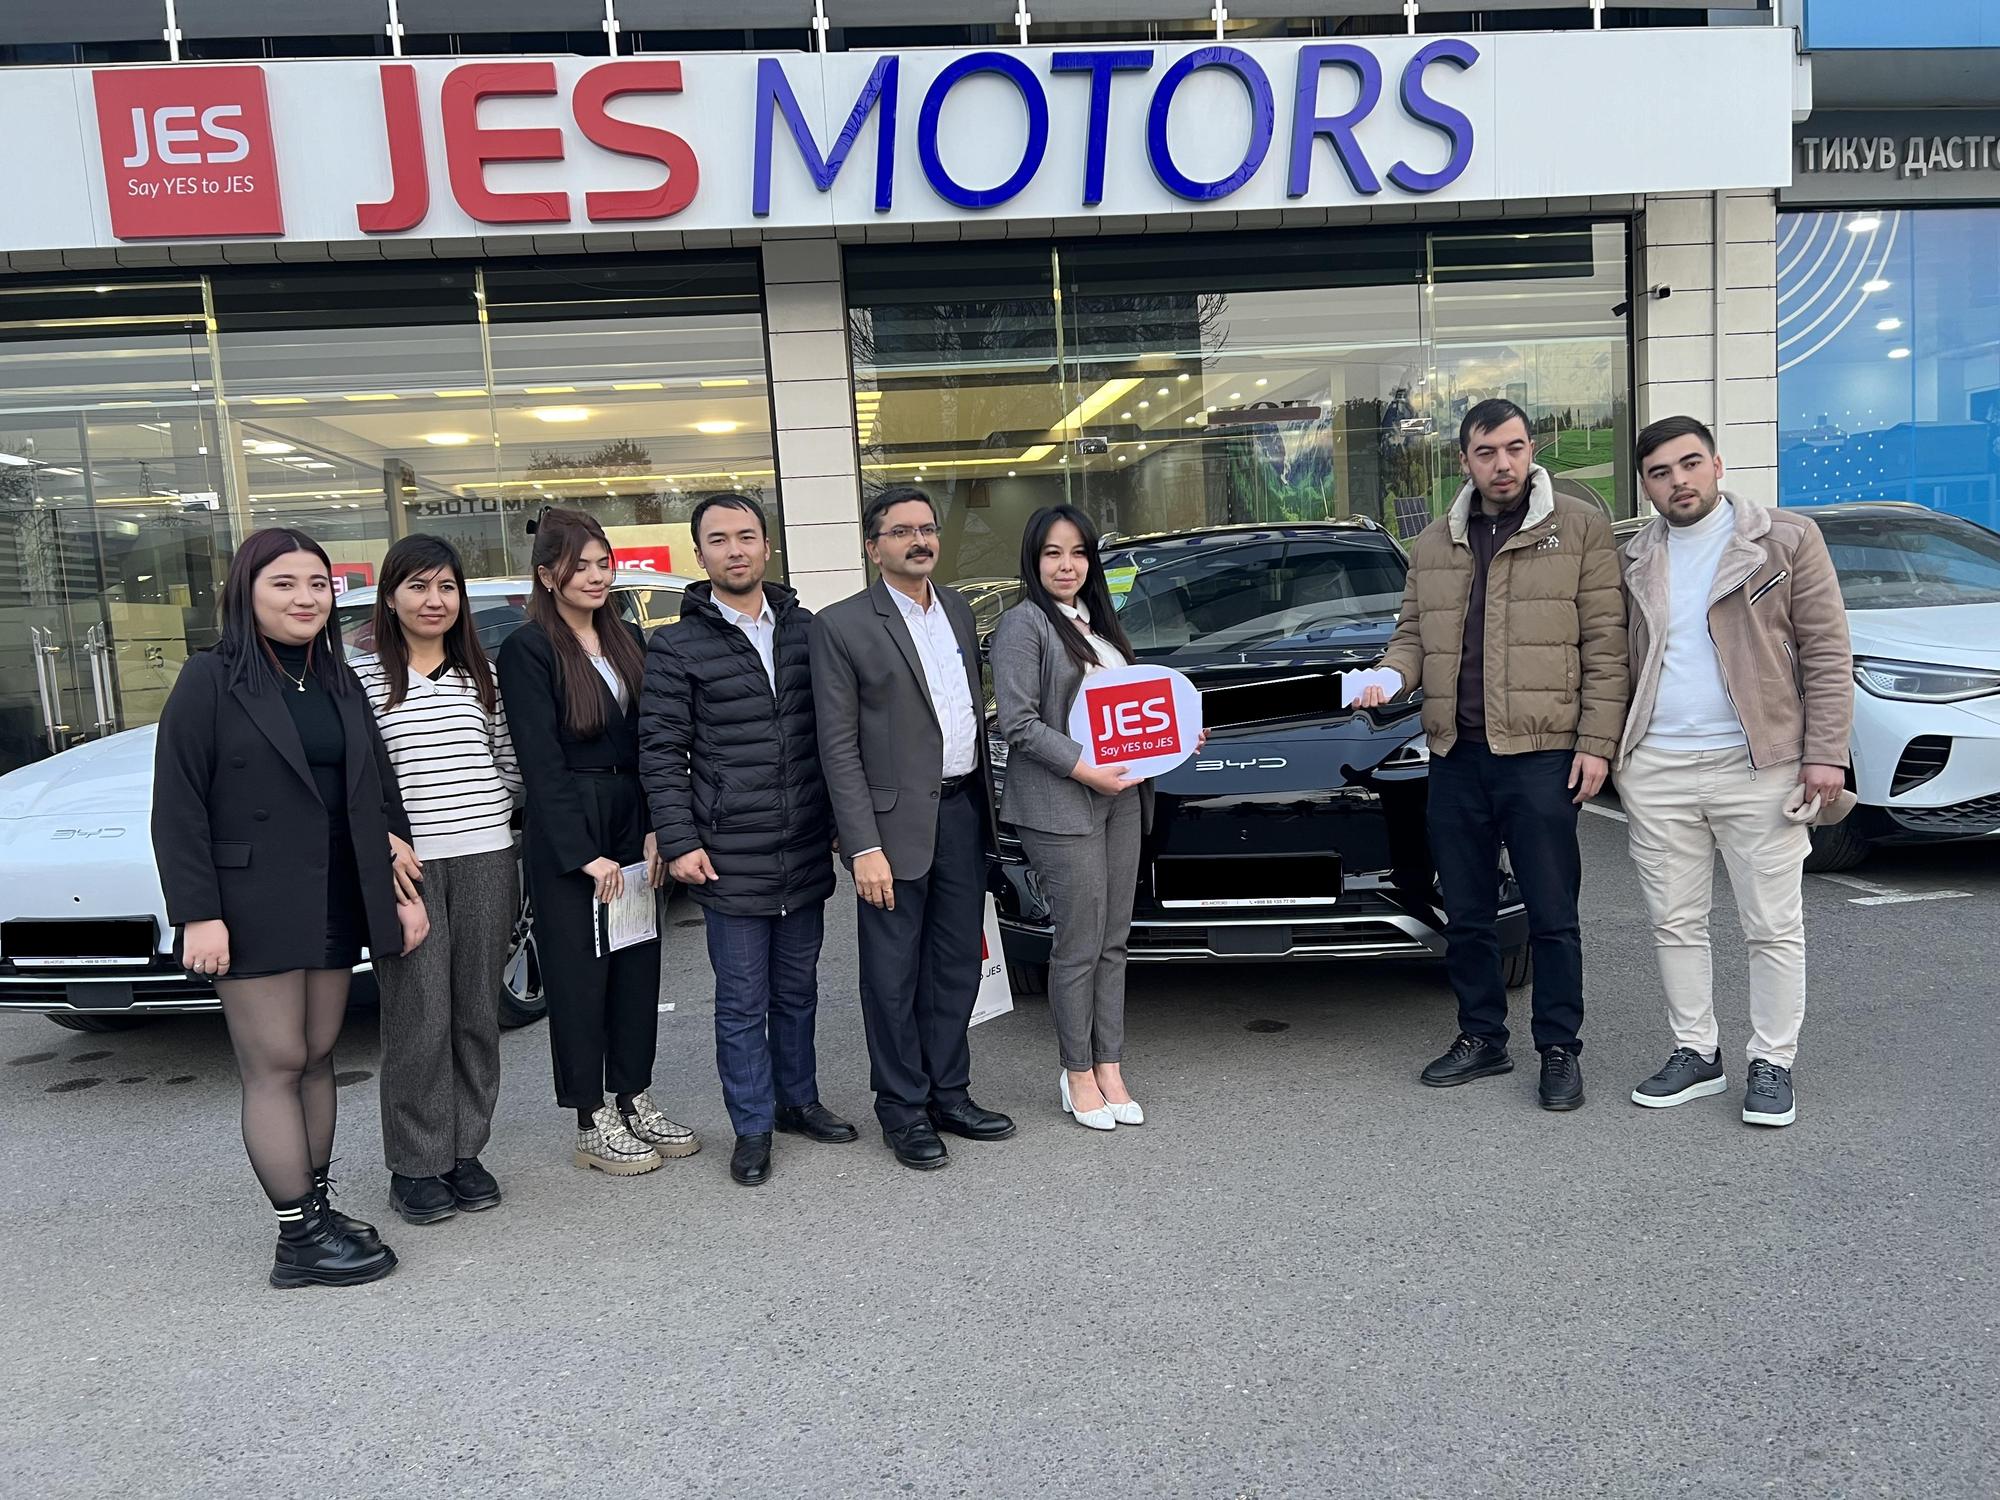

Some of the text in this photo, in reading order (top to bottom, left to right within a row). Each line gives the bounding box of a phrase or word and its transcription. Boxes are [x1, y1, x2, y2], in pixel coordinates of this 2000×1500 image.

[123, 105, 250, 168] JES
[355, 38, 1481, 235] JES MOTORS
[1803, 135, 2000, 177] ТИКУВ ДАСТГ
[128, 175, 254, 199] Say YES to JES
[1098, 697, 1171, 741] JES
[1100, 736, 1174, 757] Say YES to JES
[1195, 757, 1288, 772] BYD
[50, 828, 126, 840] BYD
[986, 964, 1001, 978] JES
